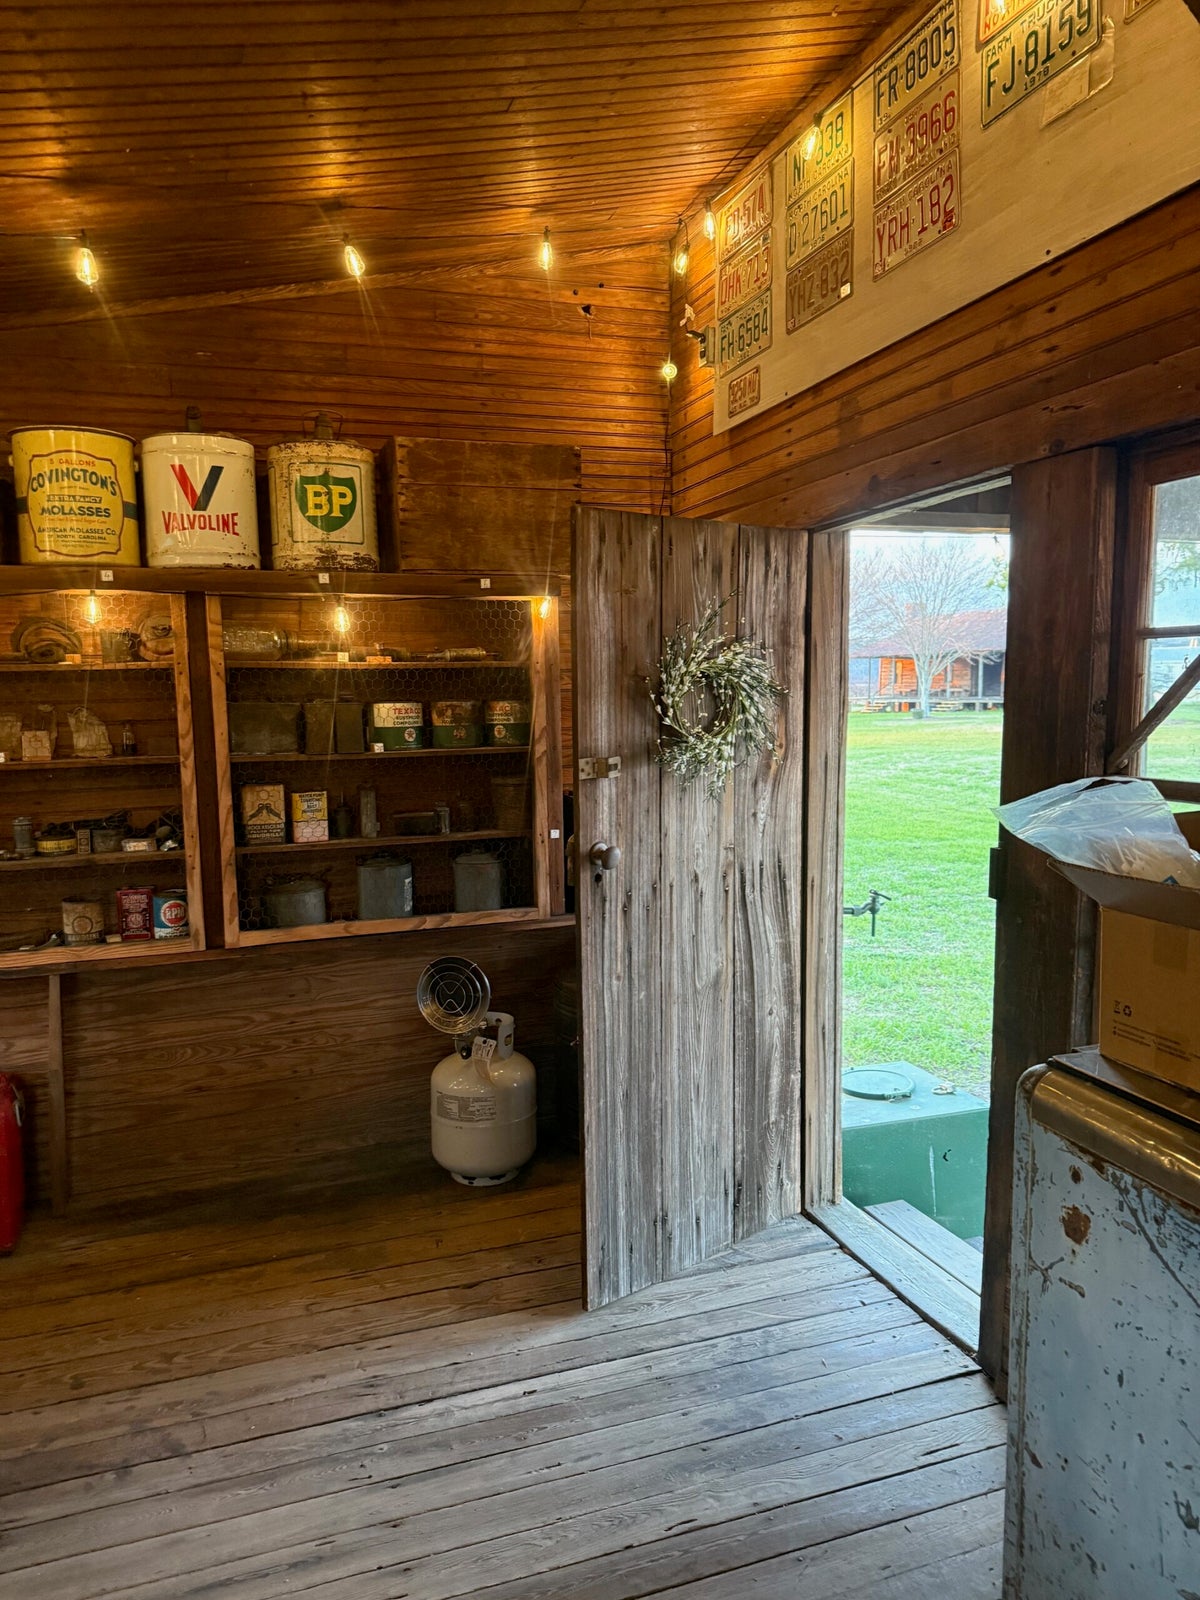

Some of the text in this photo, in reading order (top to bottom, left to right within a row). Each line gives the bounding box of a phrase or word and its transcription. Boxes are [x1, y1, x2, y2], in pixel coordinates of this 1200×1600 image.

[986, 33, 1012, 62] FARM
[1023, 66, 1050, 91] 1978
[813, 167, 849, 199] CAROLINA
[908, 159, 953, 201] CAROLINA
[58, 458, 96, 467] GALLONS
[30, 466, 117, 497] COVINGTON'S
[170, 463, 225, 512] V
[40, 504, 111, 518] MOLASSES
[303, 484, 353, 518] BP
[69, 526, 104, 535] MOLASSES
[161, 511, 240, 537] VALVOLINE
[165, 906, 185, 919] RPM
